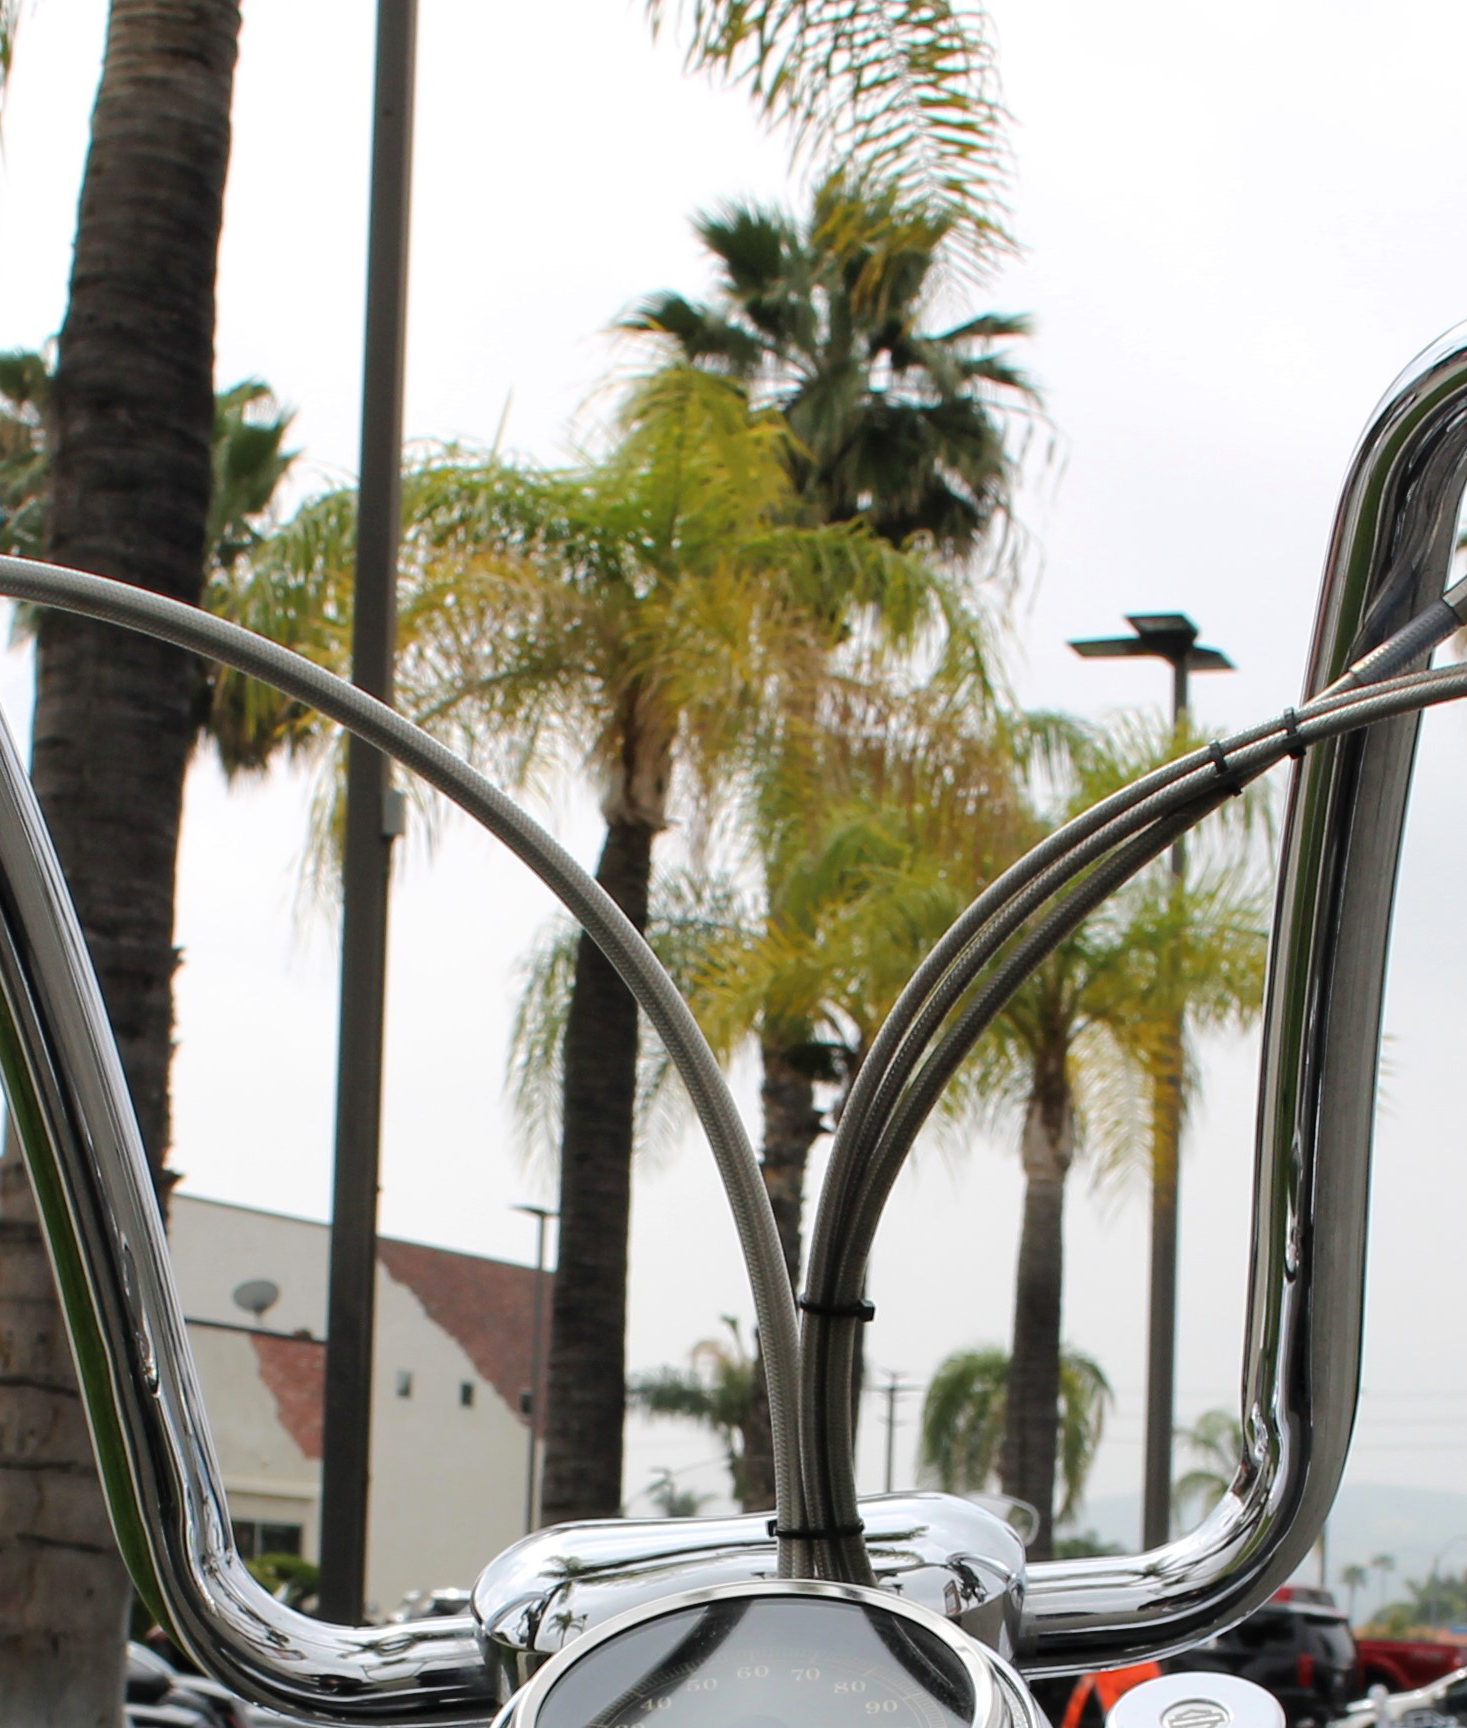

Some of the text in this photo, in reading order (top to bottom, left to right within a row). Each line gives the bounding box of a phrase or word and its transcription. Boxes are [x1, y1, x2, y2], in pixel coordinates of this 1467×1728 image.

[736, 1664, 770, 1681] 60
[790, 1666, 822, 1682] 70
[686, 1677, 718, 1693] 50
[833, 1679, 867, 1695] 80
[640, 1695, 673, 1713] 40
[864, 1698, 899, 1715] 90
